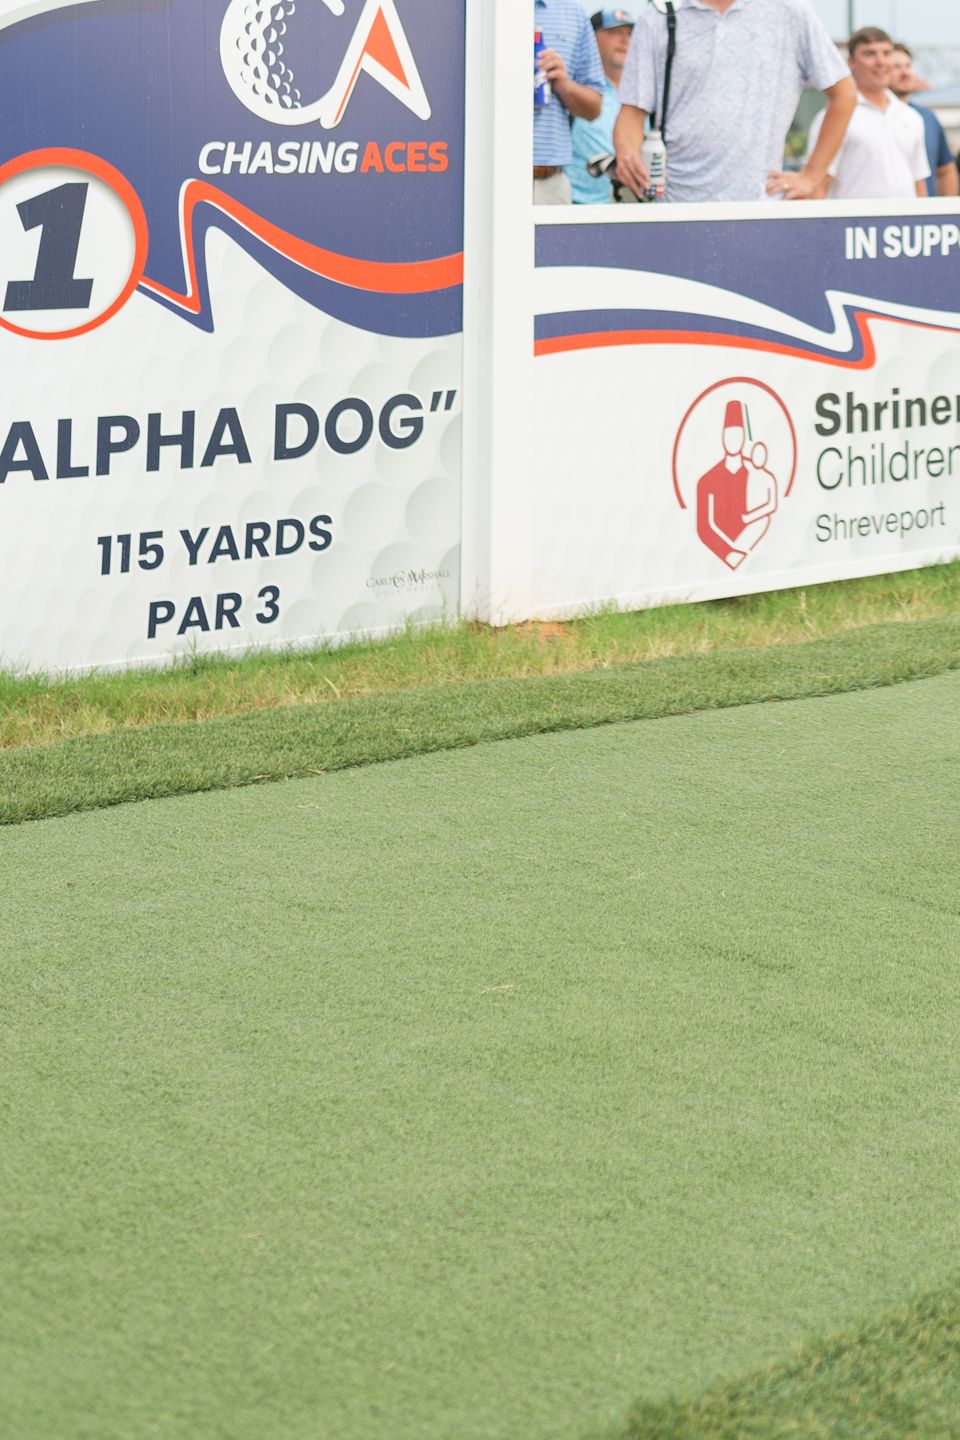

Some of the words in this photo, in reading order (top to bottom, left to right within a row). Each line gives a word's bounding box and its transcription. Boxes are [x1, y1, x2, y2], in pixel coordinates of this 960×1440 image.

[3, 182, 94, 312] 1
[845, 225, 877, 260] IN
[0, 407, 252, 483] ALPHA
[97, 530, 164, 576] 115
[179, 514, 333, 566] YARDS
[815, 501, 946, 543] Shreveport
[147, 592, 242, 639] PAR
[256, 585, 280, 624] 3
